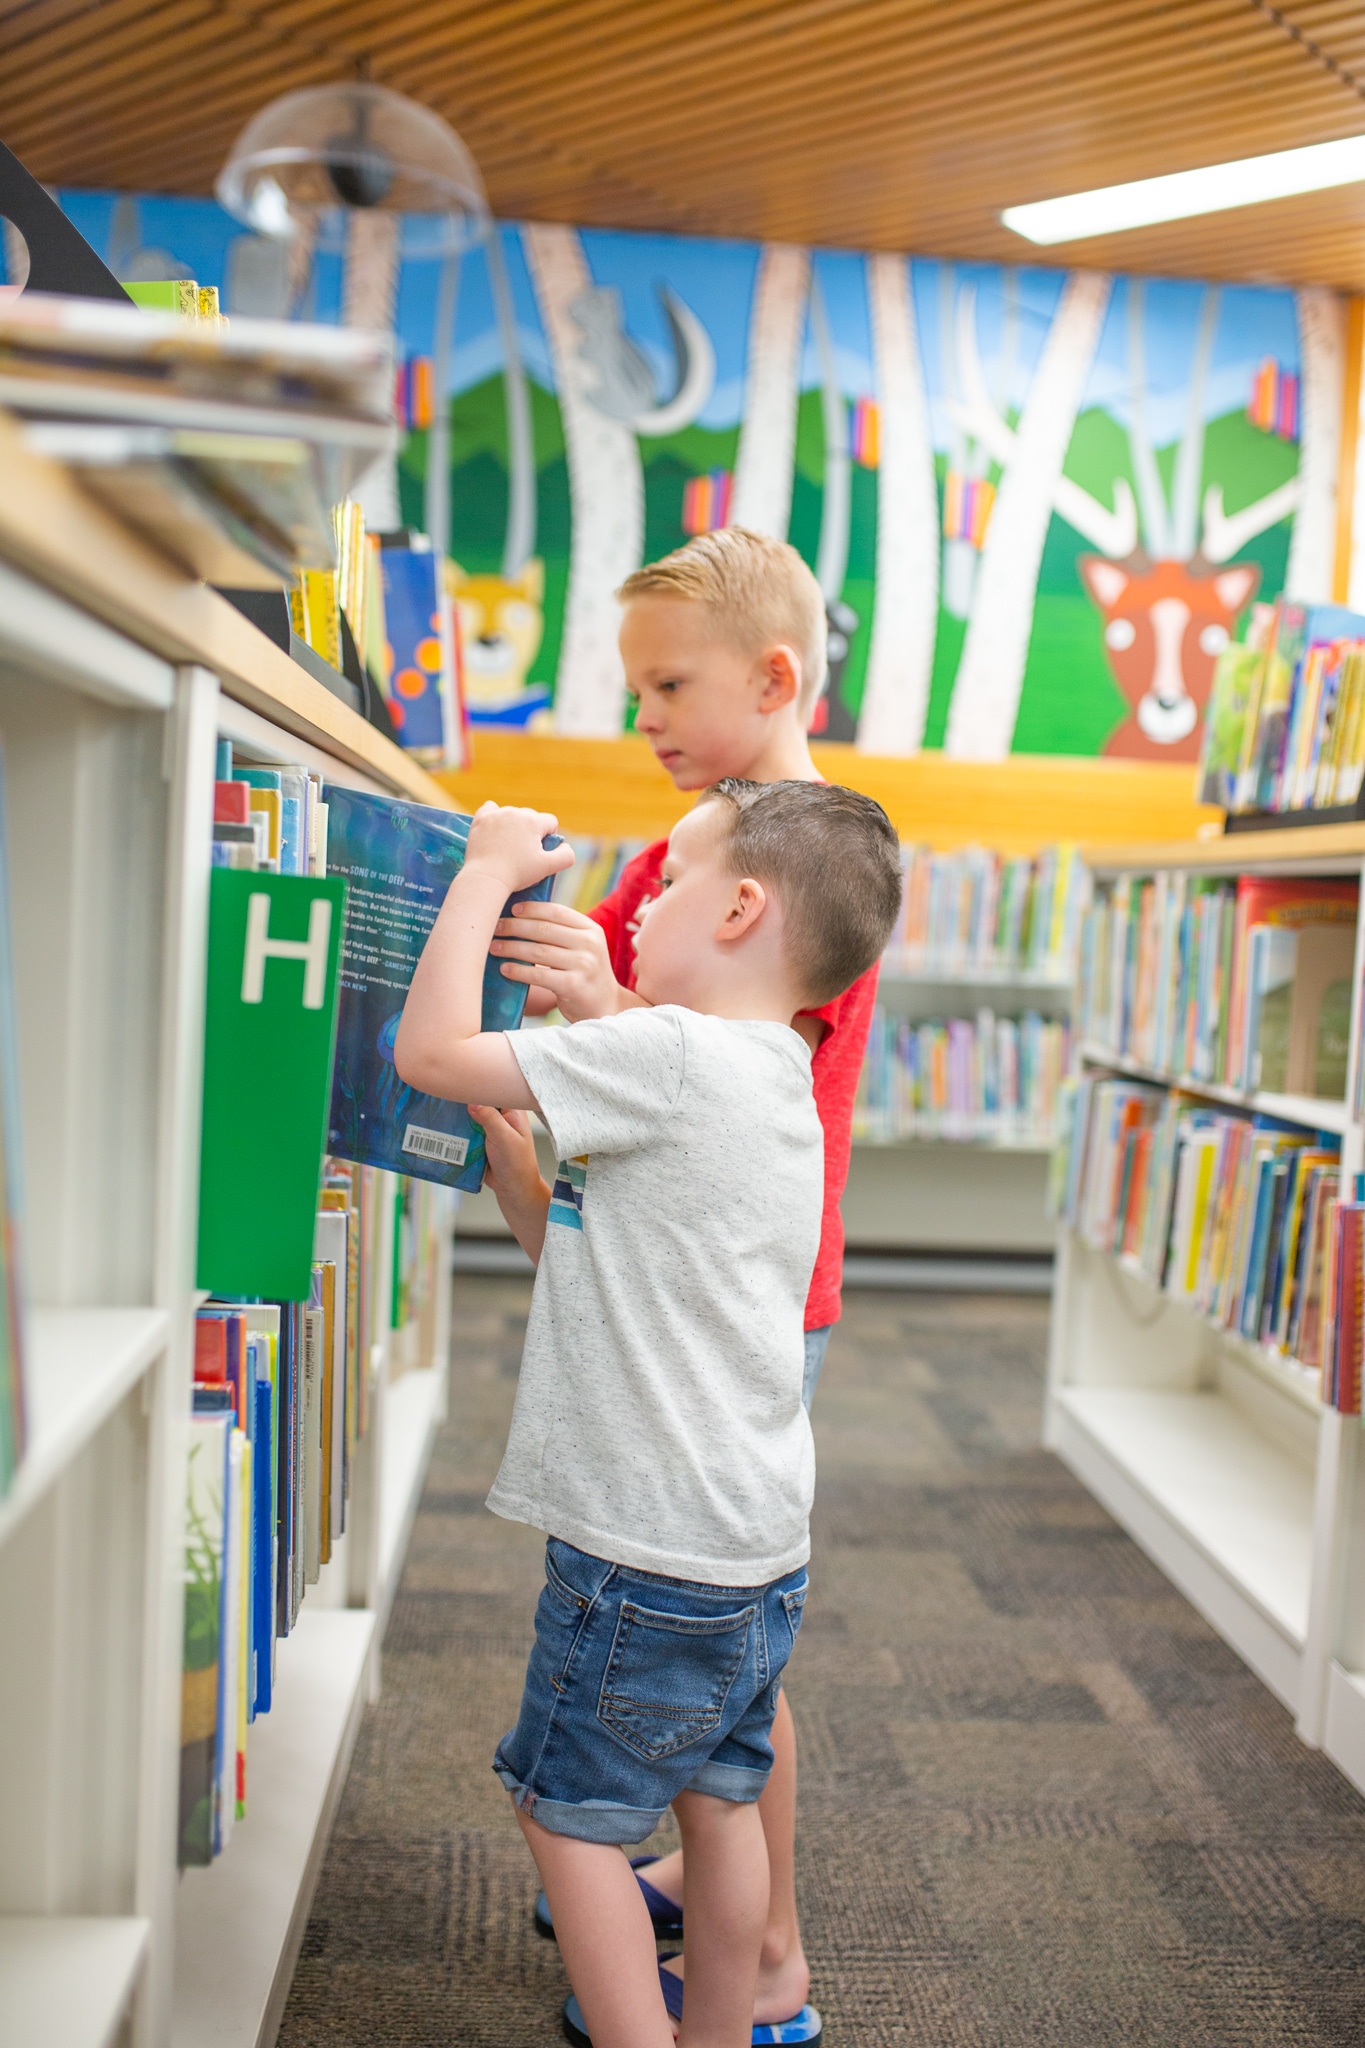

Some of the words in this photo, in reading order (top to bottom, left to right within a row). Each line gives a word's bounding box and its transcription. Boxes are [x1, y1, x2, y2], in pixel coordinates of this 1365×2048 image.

[340, 865, 349, 874] the
[350, 865, 369, 879] SONG
[370, 871, 377, 879] OF
[378, 872, 388, 881] THE
[388, 874, 405, 886] DEEP
[405, 881, 418, 890] video
[352, 886, 374, 899] featuring
[375, 893, 395, 902] colorful
[395, 897, 422, 908] characters
[422, 903, 432, 911] and
[370, 903, 379, 911] But
[380, 905, 388, 913] the
[389, 908, 402, 916] team
[374, 916, 393, 927] fantasy
[412, 924, 420, 932] the
[241, 892, 332, 1010] H
[352, 941, 363, 949] that
[352, 982, 369, 993] NEWS
[366, 975, 392, 988] something
